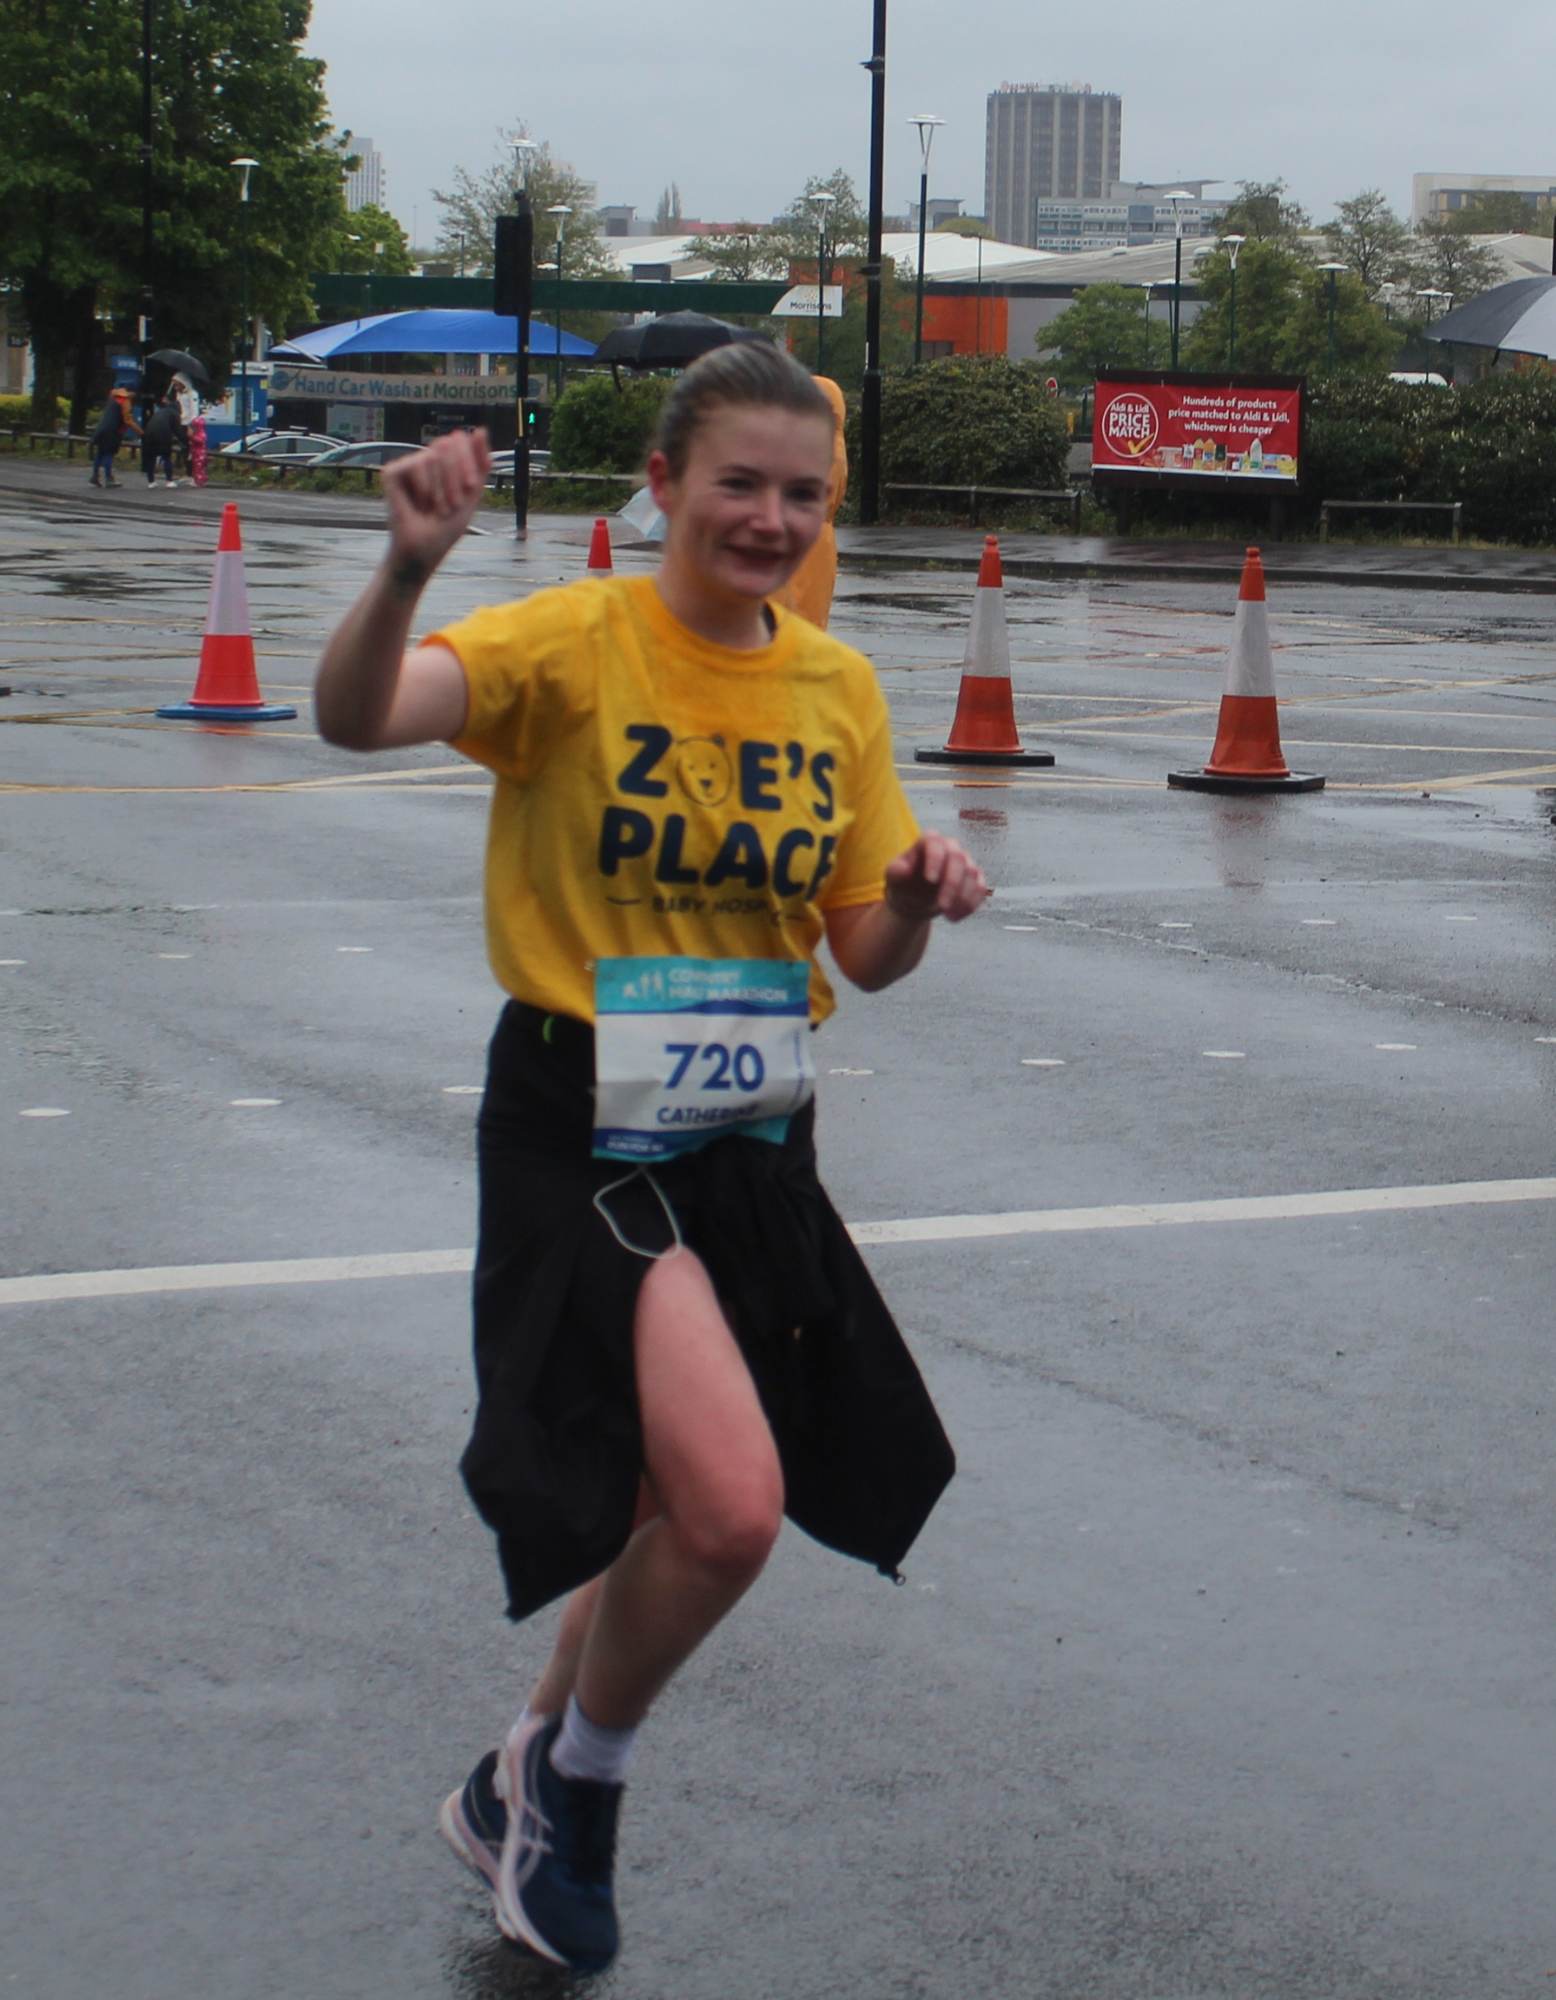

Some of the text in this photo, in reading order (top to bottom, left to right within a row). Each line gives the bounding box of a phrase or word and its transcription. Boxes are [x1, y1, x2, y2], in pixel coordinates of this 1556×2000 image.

[295, 375, 518, 399] Hand Car Wash at Morrisons
[1110, 402, 1150, 413] Aldi & Lidl
[1183, 396, 1277, 410] Hundreds of products
[1109, 412, 1150, 428] PRICE
[1168, 408, 1290, 423] price matched to Aldi & Lidl,
[1109, 426, 1151, 439] MATCH
[1184, 421, 1273, 435] whichever is cheaper
[664, 1043, 765, 1093] 720
[657, 1100, 760, 1125] CATHER
